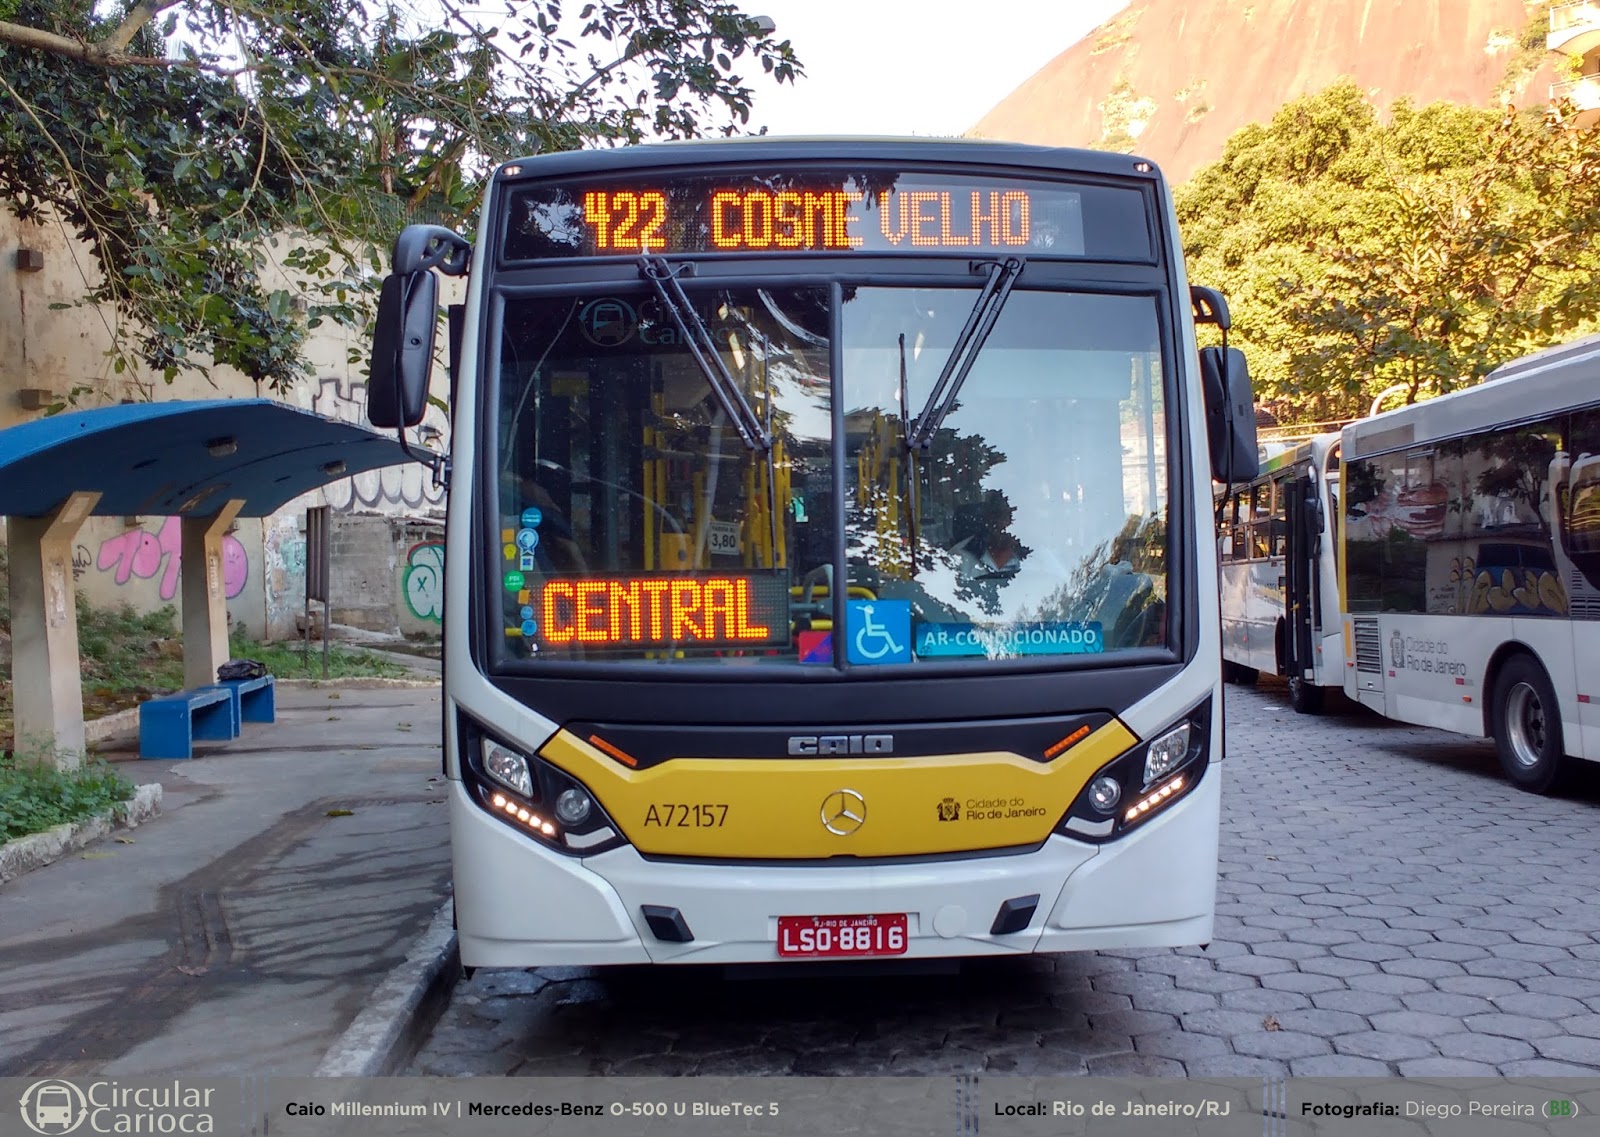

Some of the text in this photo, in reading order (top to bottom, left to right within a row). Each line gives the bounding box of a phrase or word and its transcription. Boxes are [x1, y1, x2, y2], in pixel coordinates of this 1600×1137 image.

[584, 189, 1031, 249] 422 COSME VELHO
[711, 533, 736, 549] 3,80
[542, 578, 769, 642] CENTRAL
[1406, 654, 1420, 671] Rio
[1434, 658, 1467, 676] Janeiro
[788, 735, 894, 755] CAIO
[966, 797, 1025, 810] Cidade do
[966, 806, 1047, 821] Rio de Janeiro
[643, 804, 729, 827] A72157
[850, 919, 878, 927] JANEIRO
